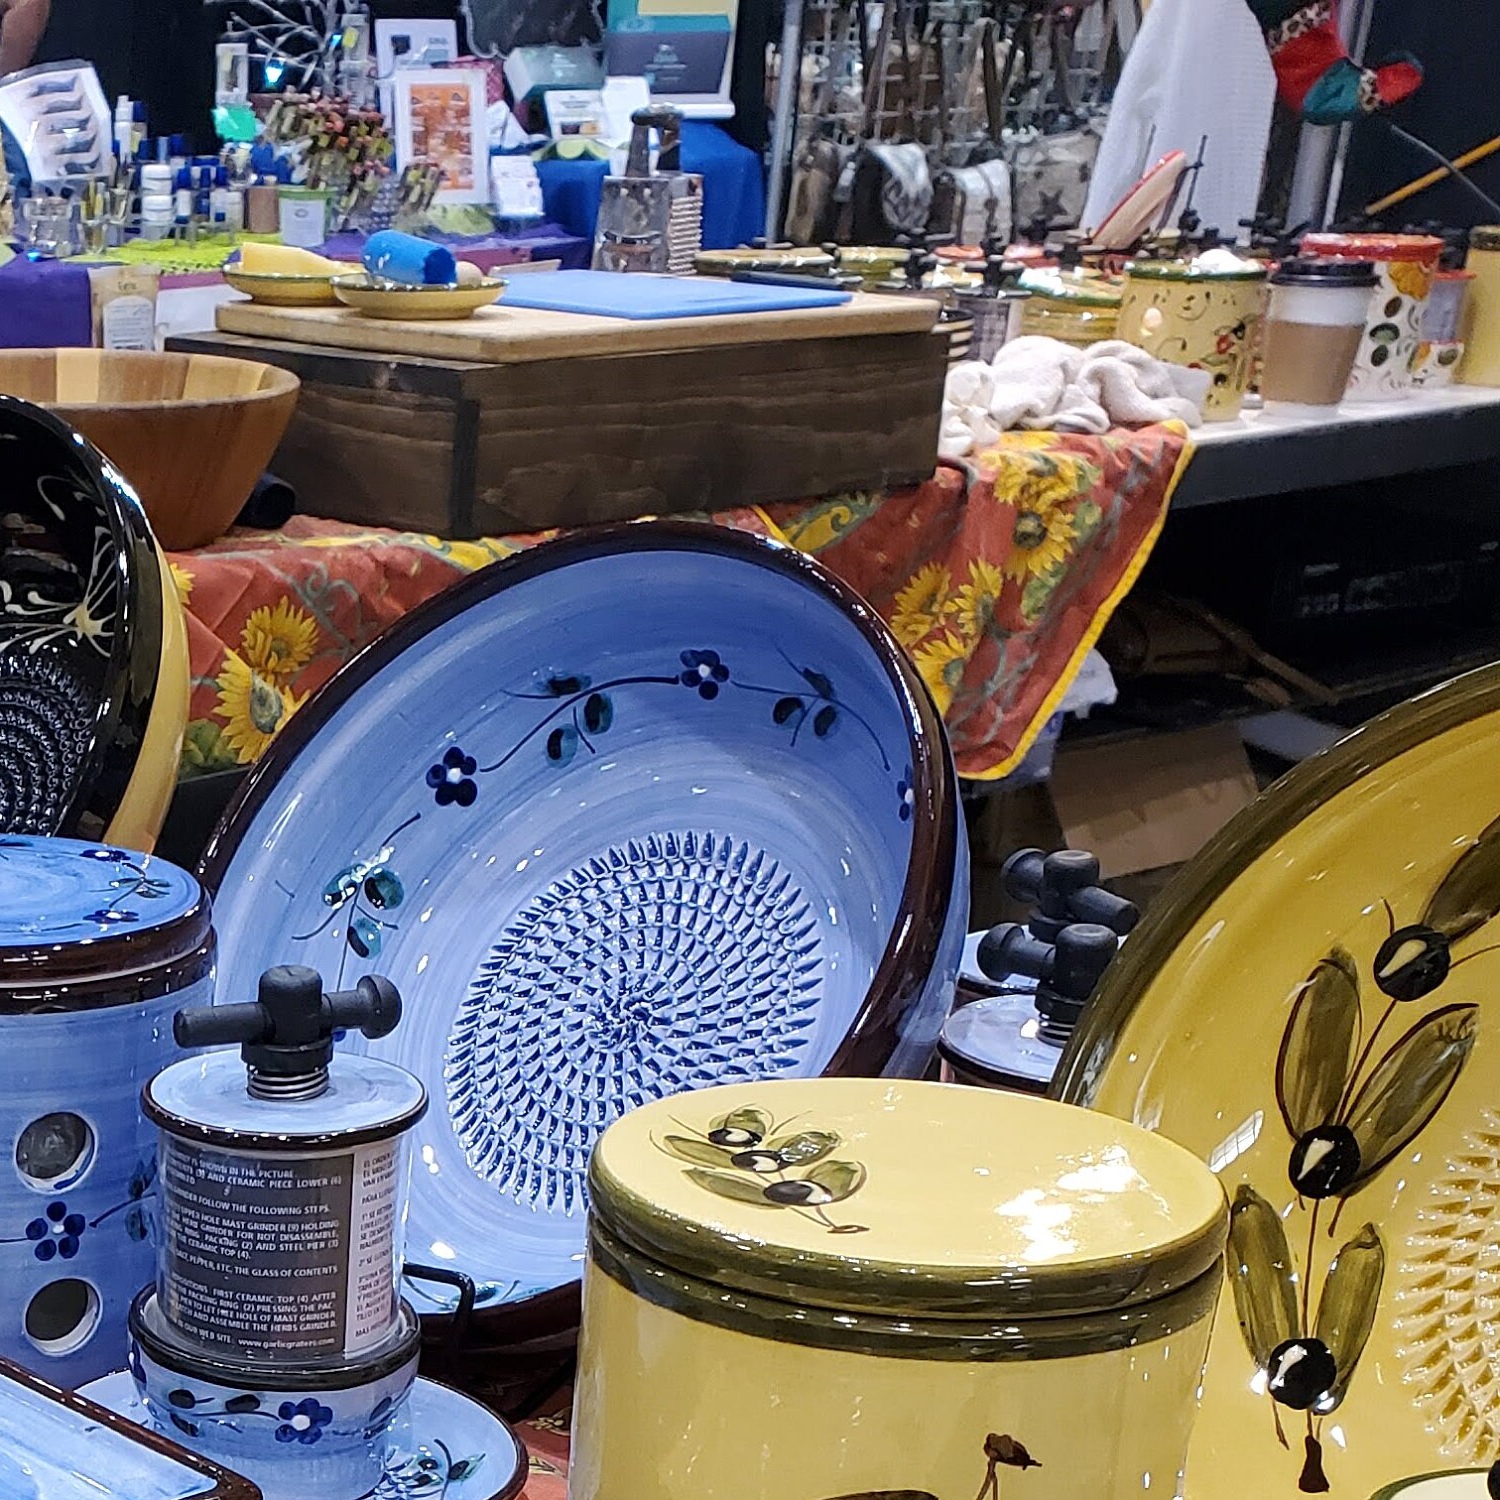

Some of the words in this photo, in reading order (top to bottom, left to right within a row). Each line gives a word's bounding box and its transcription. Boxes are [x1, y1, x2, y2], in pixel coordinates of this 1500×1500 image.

[270, 1180, 292, 1188] PIECE
[297, 1179, 327, 1188] LOWER
[232, 1204, 246, 1213] THE
[250, 1206, 301, 1215] FOLLOWING
[222, 1218, 245, 1229] MAST
[237, 1230, 253, 1239] FOR
[257, 1233, 276, 1241] NOT
[256, 1243, 276, 1251] AND
[220, 1247, 235, 1257] TOP
[252, 1269, 279, 1277] GLASS
[280, 1269, 292, 1277] OF
[293, 1265, 338, 1277] CONTENTS
[300, 1304, 315, 1312] THE
[274, 1314, 298, 1322] MAST
[252, 1322, 268, 1331] THE
